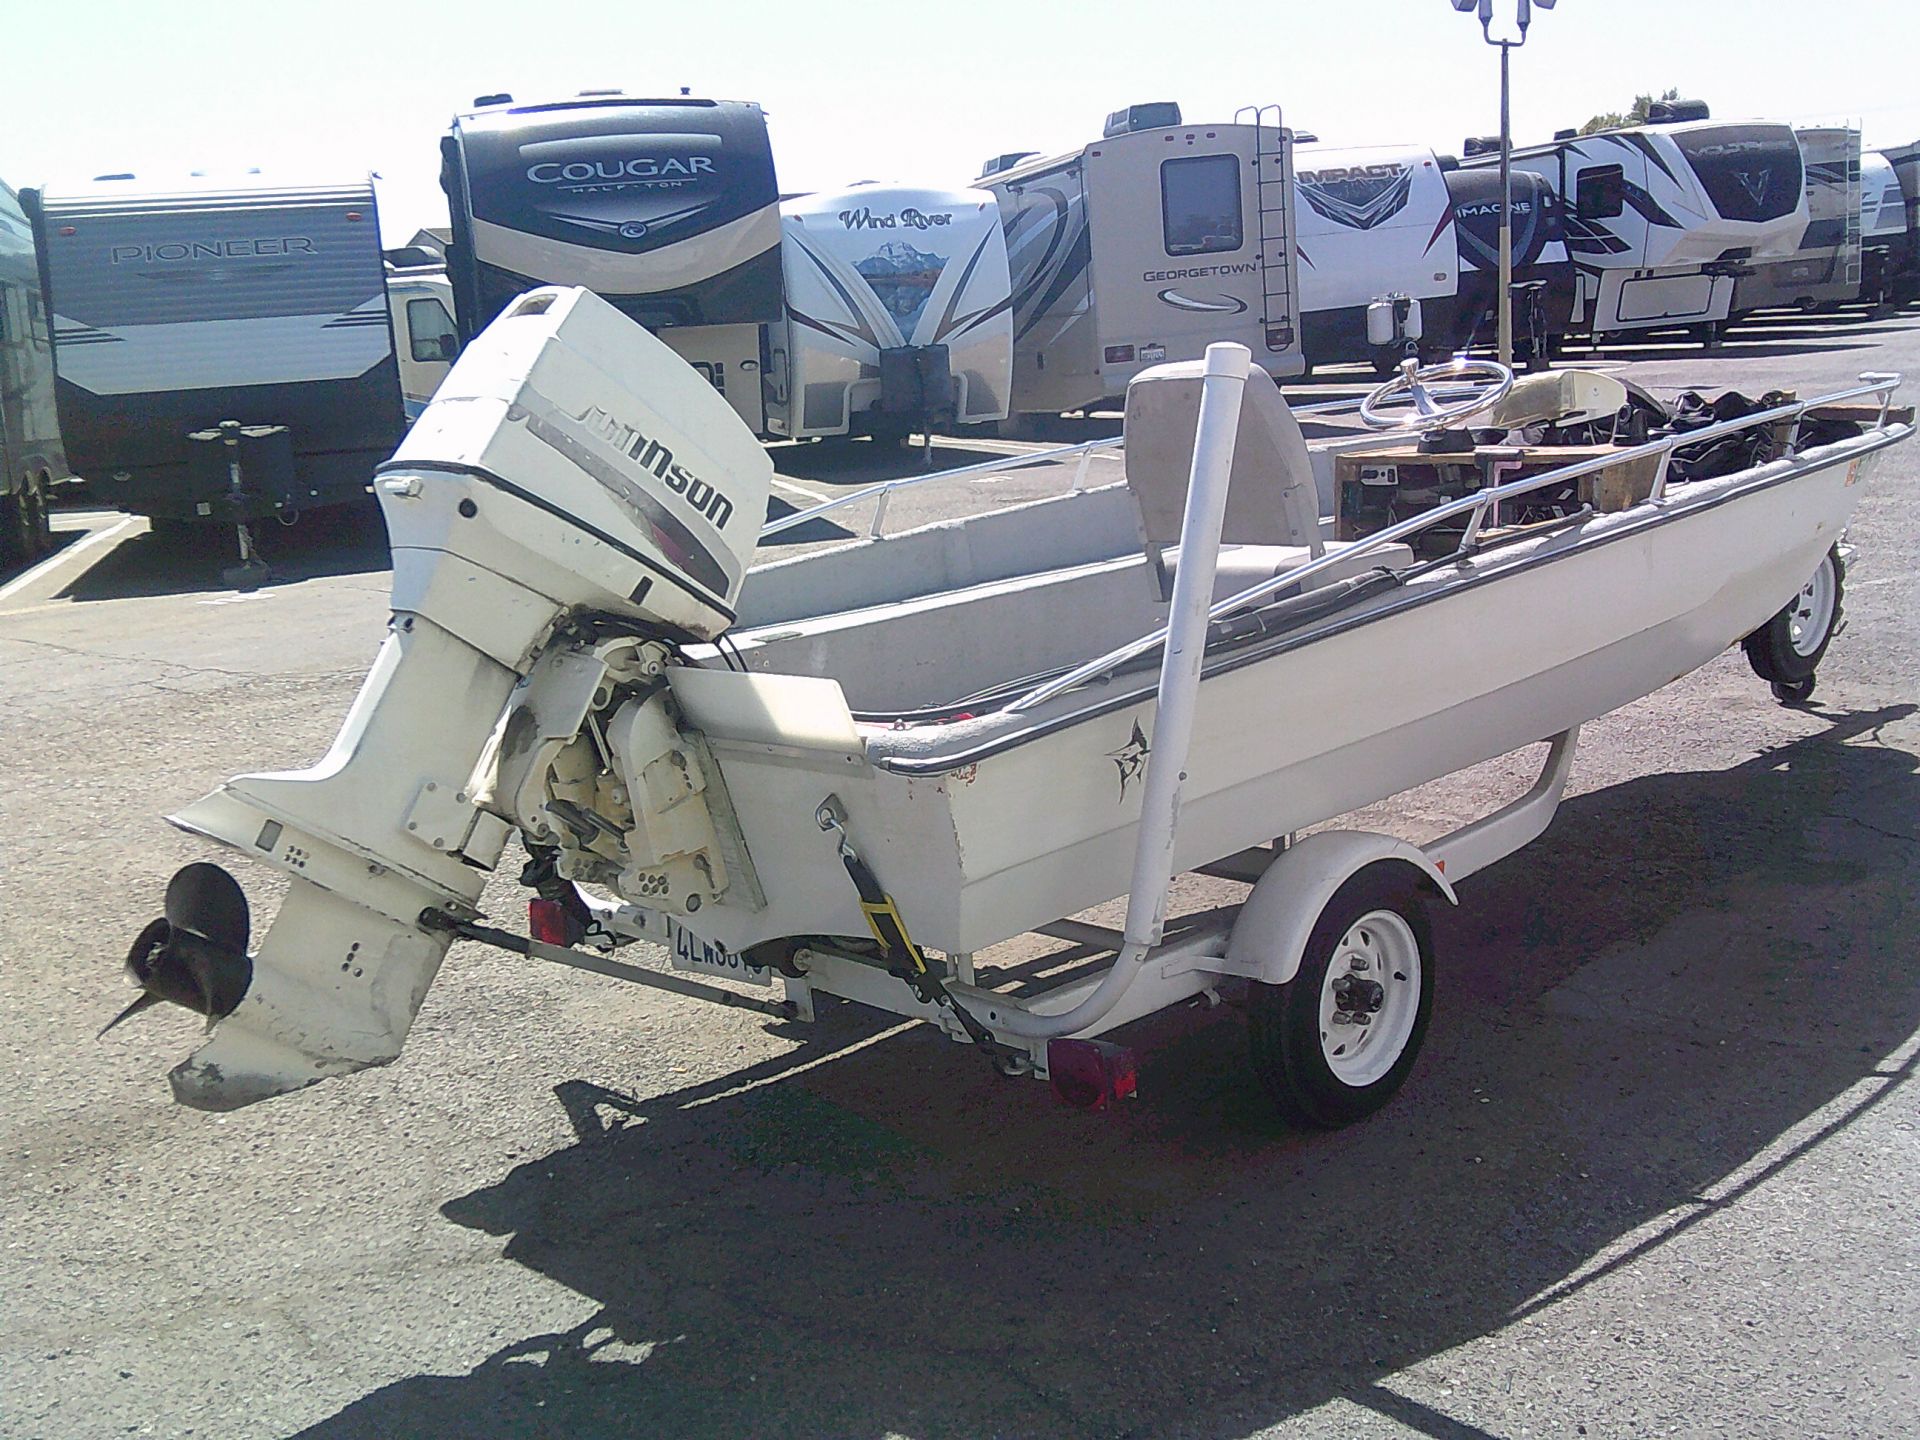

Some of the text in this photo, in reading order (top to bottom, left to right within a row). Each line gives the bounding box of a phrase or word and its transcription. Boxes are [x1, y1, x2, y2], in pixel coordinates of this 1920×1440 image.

[527, 156, 717, 183] COUGAR
[838, 206, 953, 230] Wind River
[1456, 202, 1531, 218] IMAGNE
[111, 237, 318, 264] PIONEER
[1143, 263, 1257, 282] GEORGETOWN
